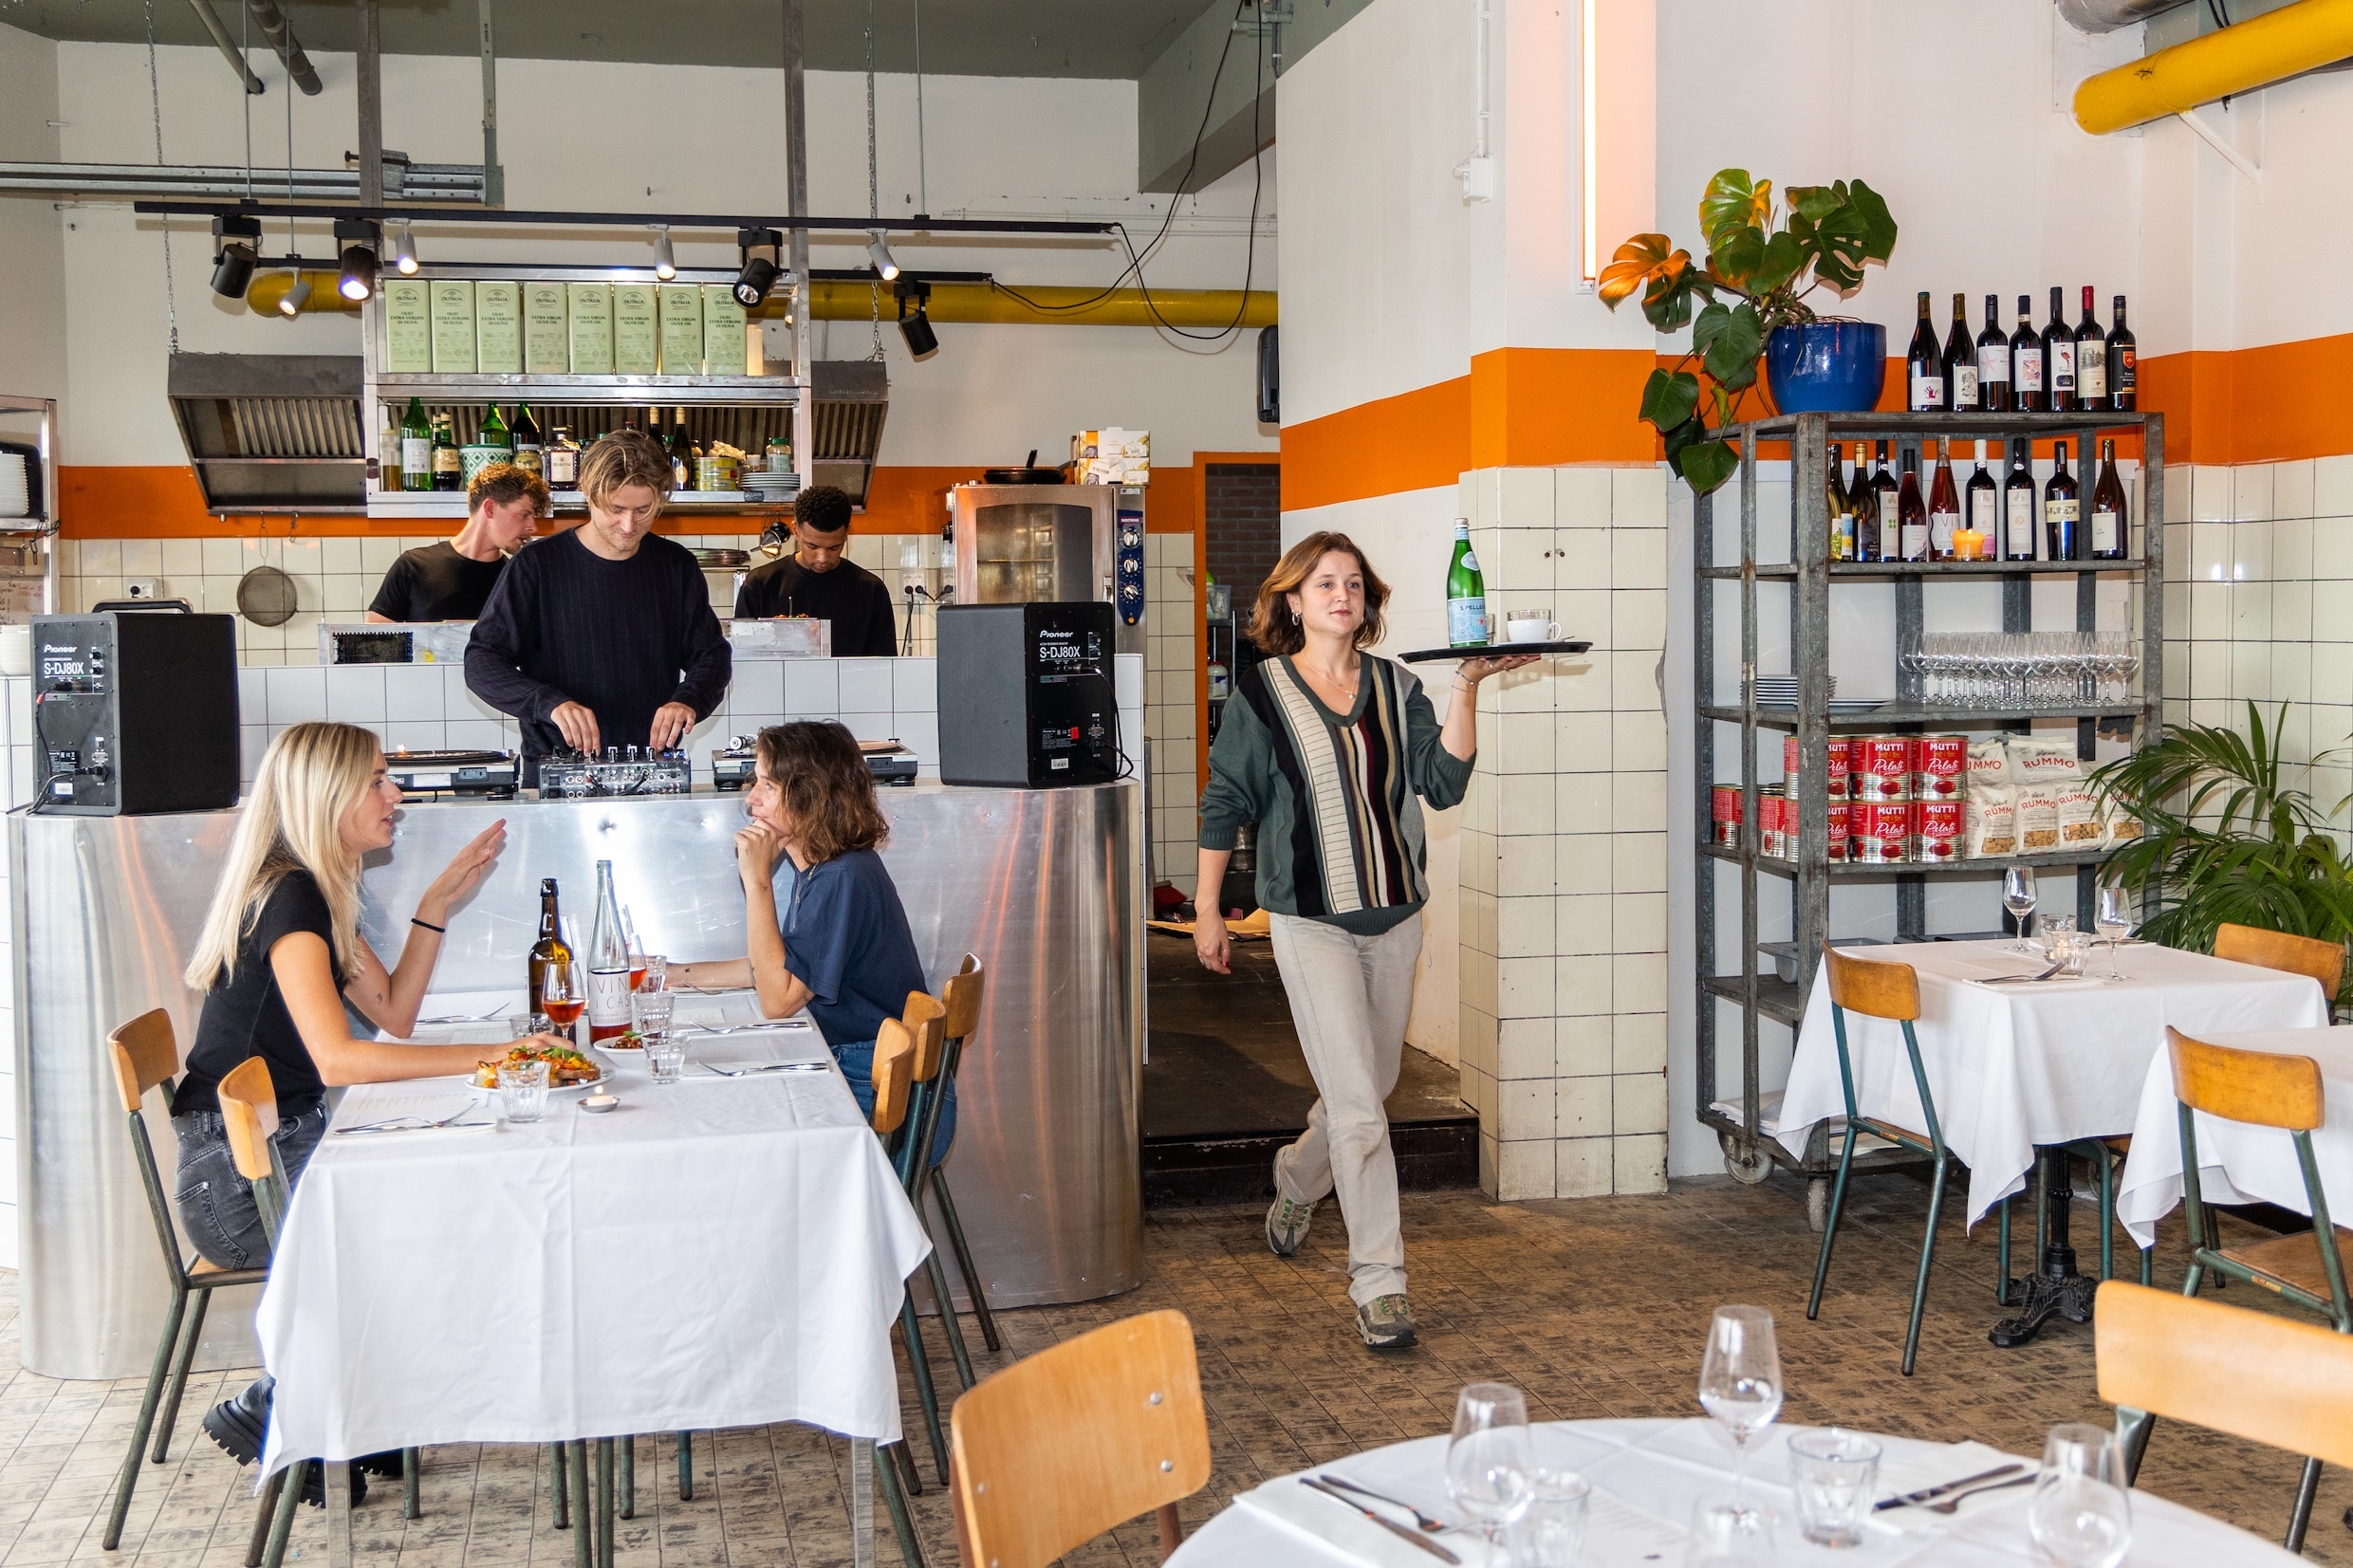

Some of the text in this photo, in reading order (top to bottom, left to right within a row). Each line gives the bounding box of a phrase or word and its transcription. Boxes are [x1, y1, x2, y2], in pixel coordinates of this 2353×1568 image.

[1039, 630, 1074, 638] Pioneer
[44, 644, 78, 653] Pioneer
[1039, 646, 1081, 658] S-DJ80X
[44, 662, 84, 675] S-DJ80X
[1875, 744, 1904, 752] MUTTI
[1930, 742, 1958, 751] MUTTI
[1872, 759, 1904, 773] Pelati
[1927, 758, 1959, 772] Pelati
[2023, 757, 2075, 769] RUMMO
[2058, 794, 2099, 805] RUMMO
[1877, 806, 1905, 815] MUTTI
[1926, 805, 1955, 814] MUTTI
[2021, 800, 2056, 811] RUMMO
[1984, 806, 2014, 818] RUMM
[1874, 822, 1904, 837] Pelati
[1923, 821, 1956, 835] Pelati
